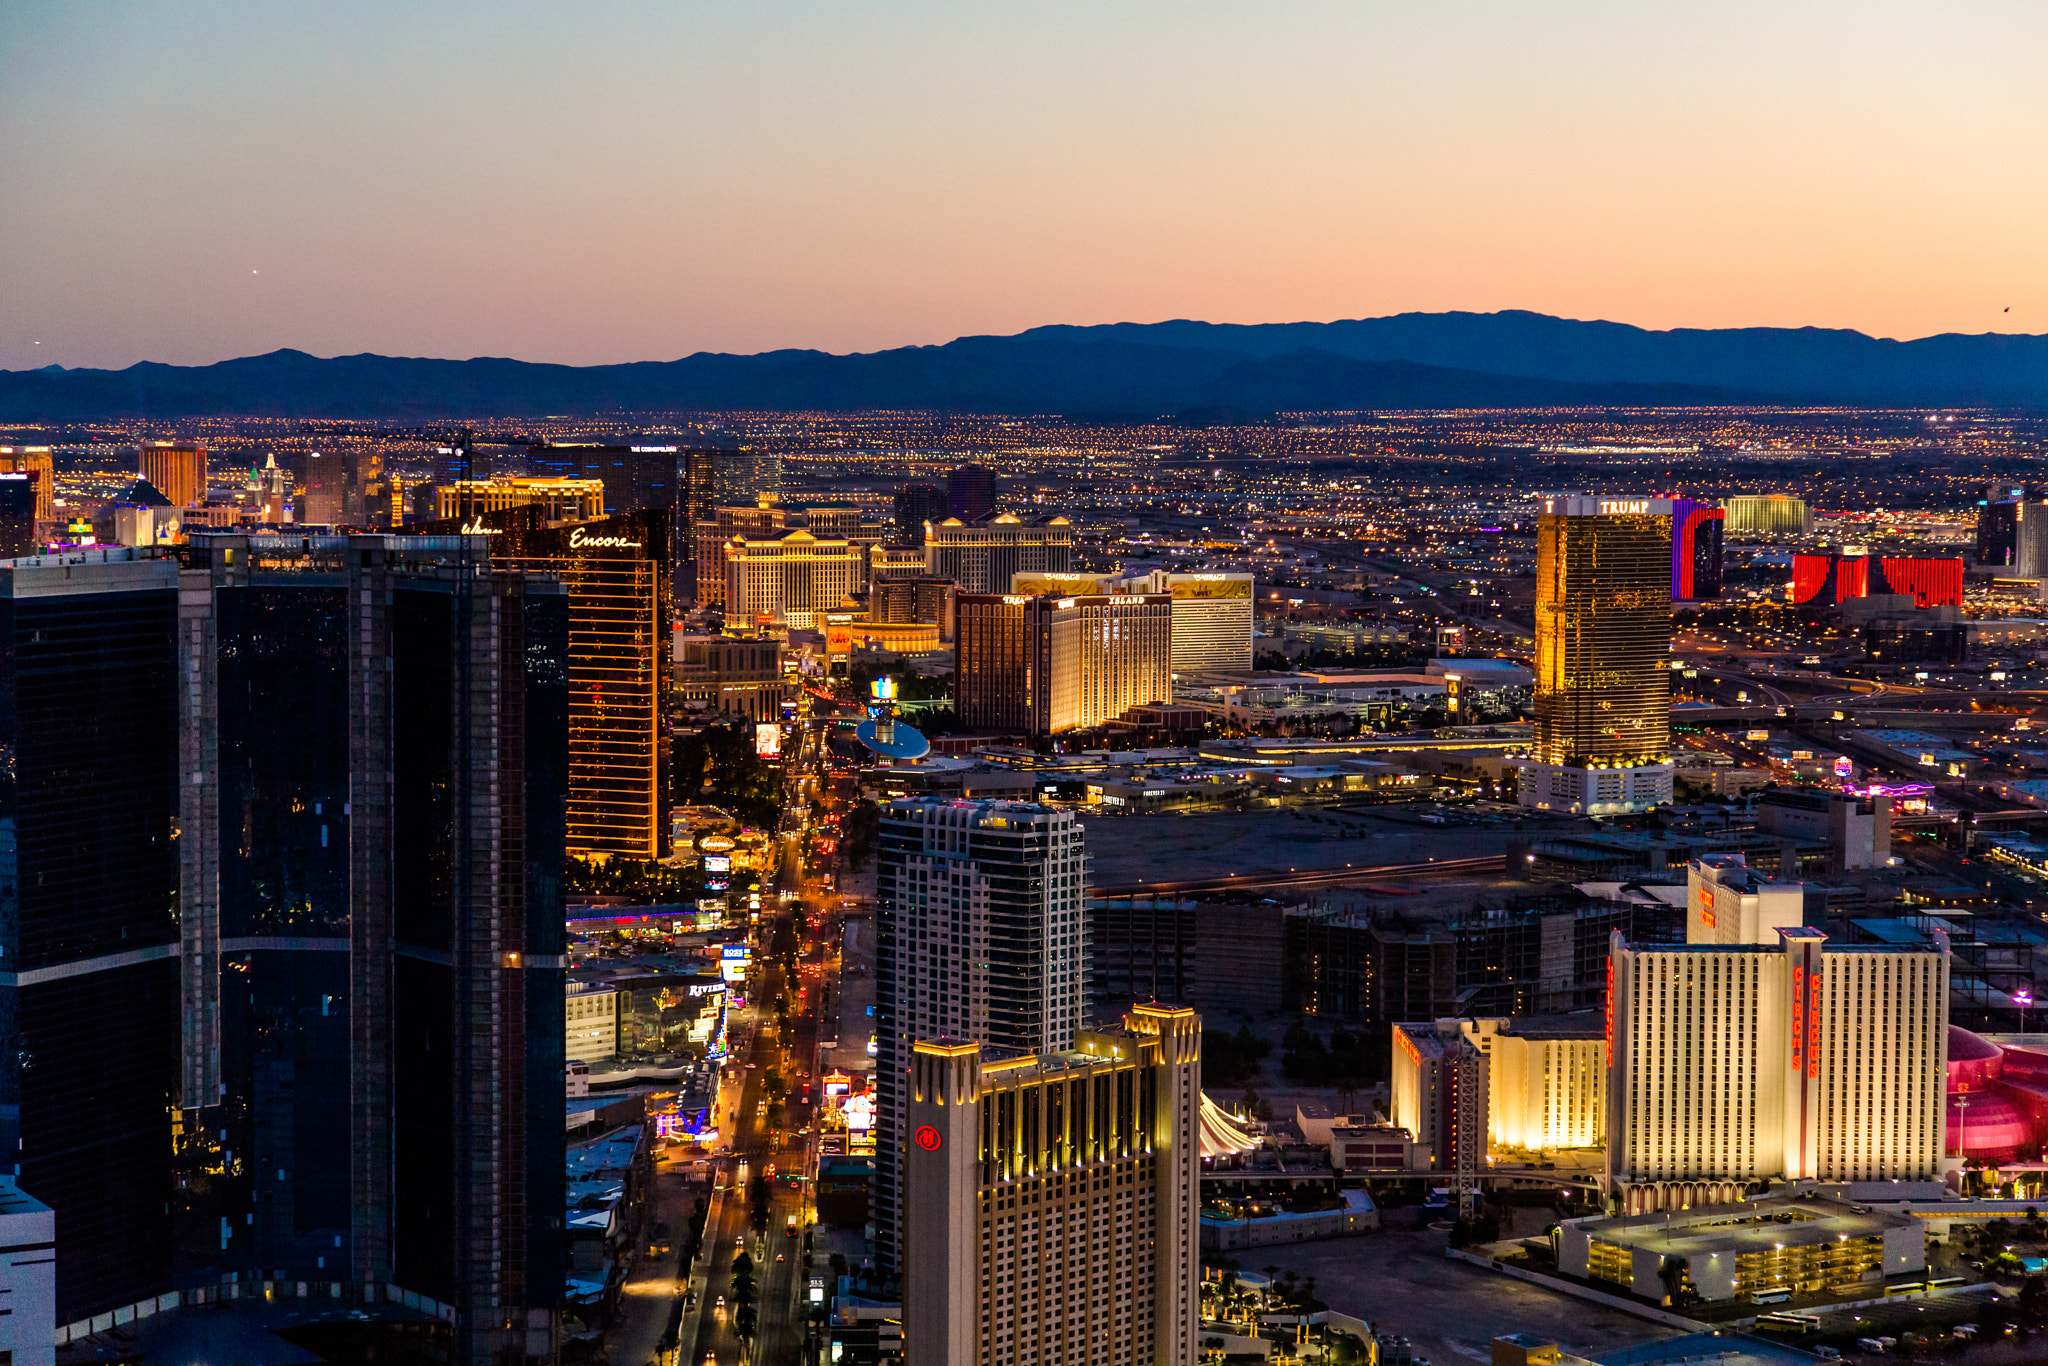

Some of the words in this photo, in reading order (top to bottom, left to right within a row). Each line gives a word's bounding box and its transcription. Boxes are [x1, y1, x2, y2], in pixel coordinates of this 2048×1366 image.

[1600, 501, 1649, 514] TRUMP
[570, 527, 642, 548] Encore
[1053, 573, 1080, 581] MIRAGE
[1201, 573, 1226, 581] MIRAGE
[1108, 596, 1145, 605] ISLAND
[1808, 974, 1820, 1079] CIRCUS
